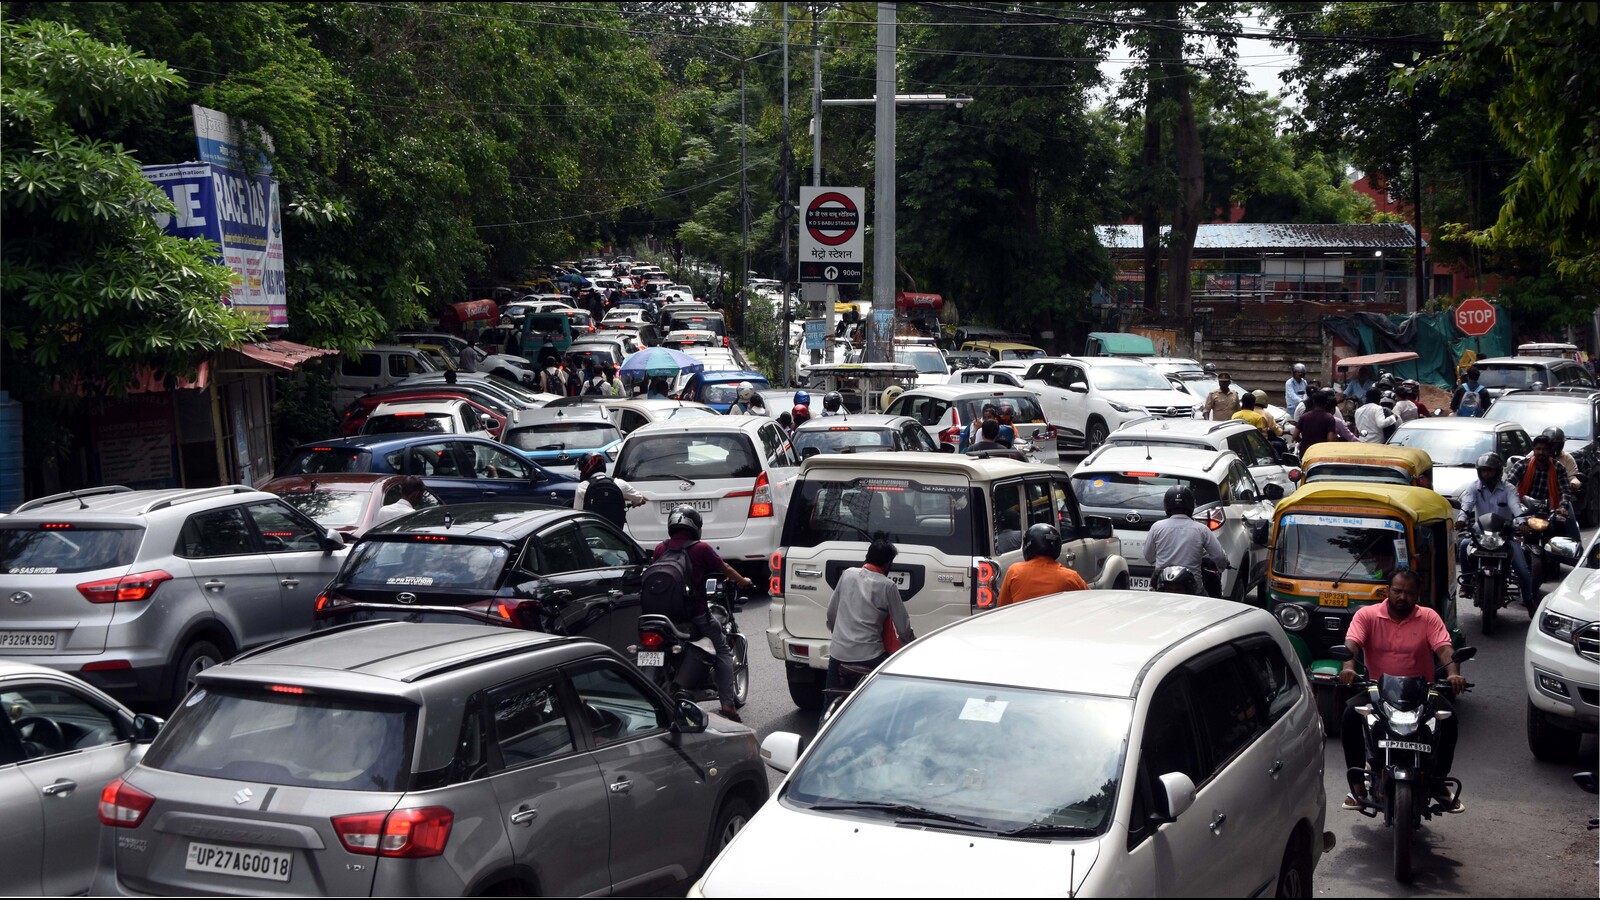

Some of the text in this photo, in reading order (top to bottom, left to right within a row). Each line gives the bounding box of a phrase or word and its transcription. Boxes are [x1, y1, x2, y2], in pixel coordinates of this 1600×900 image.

[160, 170, 205, 178] Examinations
[213, 172, 266, 228] RACE IAS
[811, 247, 852, 260] मेट्रो स्टेशन
[1459, 309, 1492, 325] STOP
[196, 847, 289, 876] UP27AG0018
